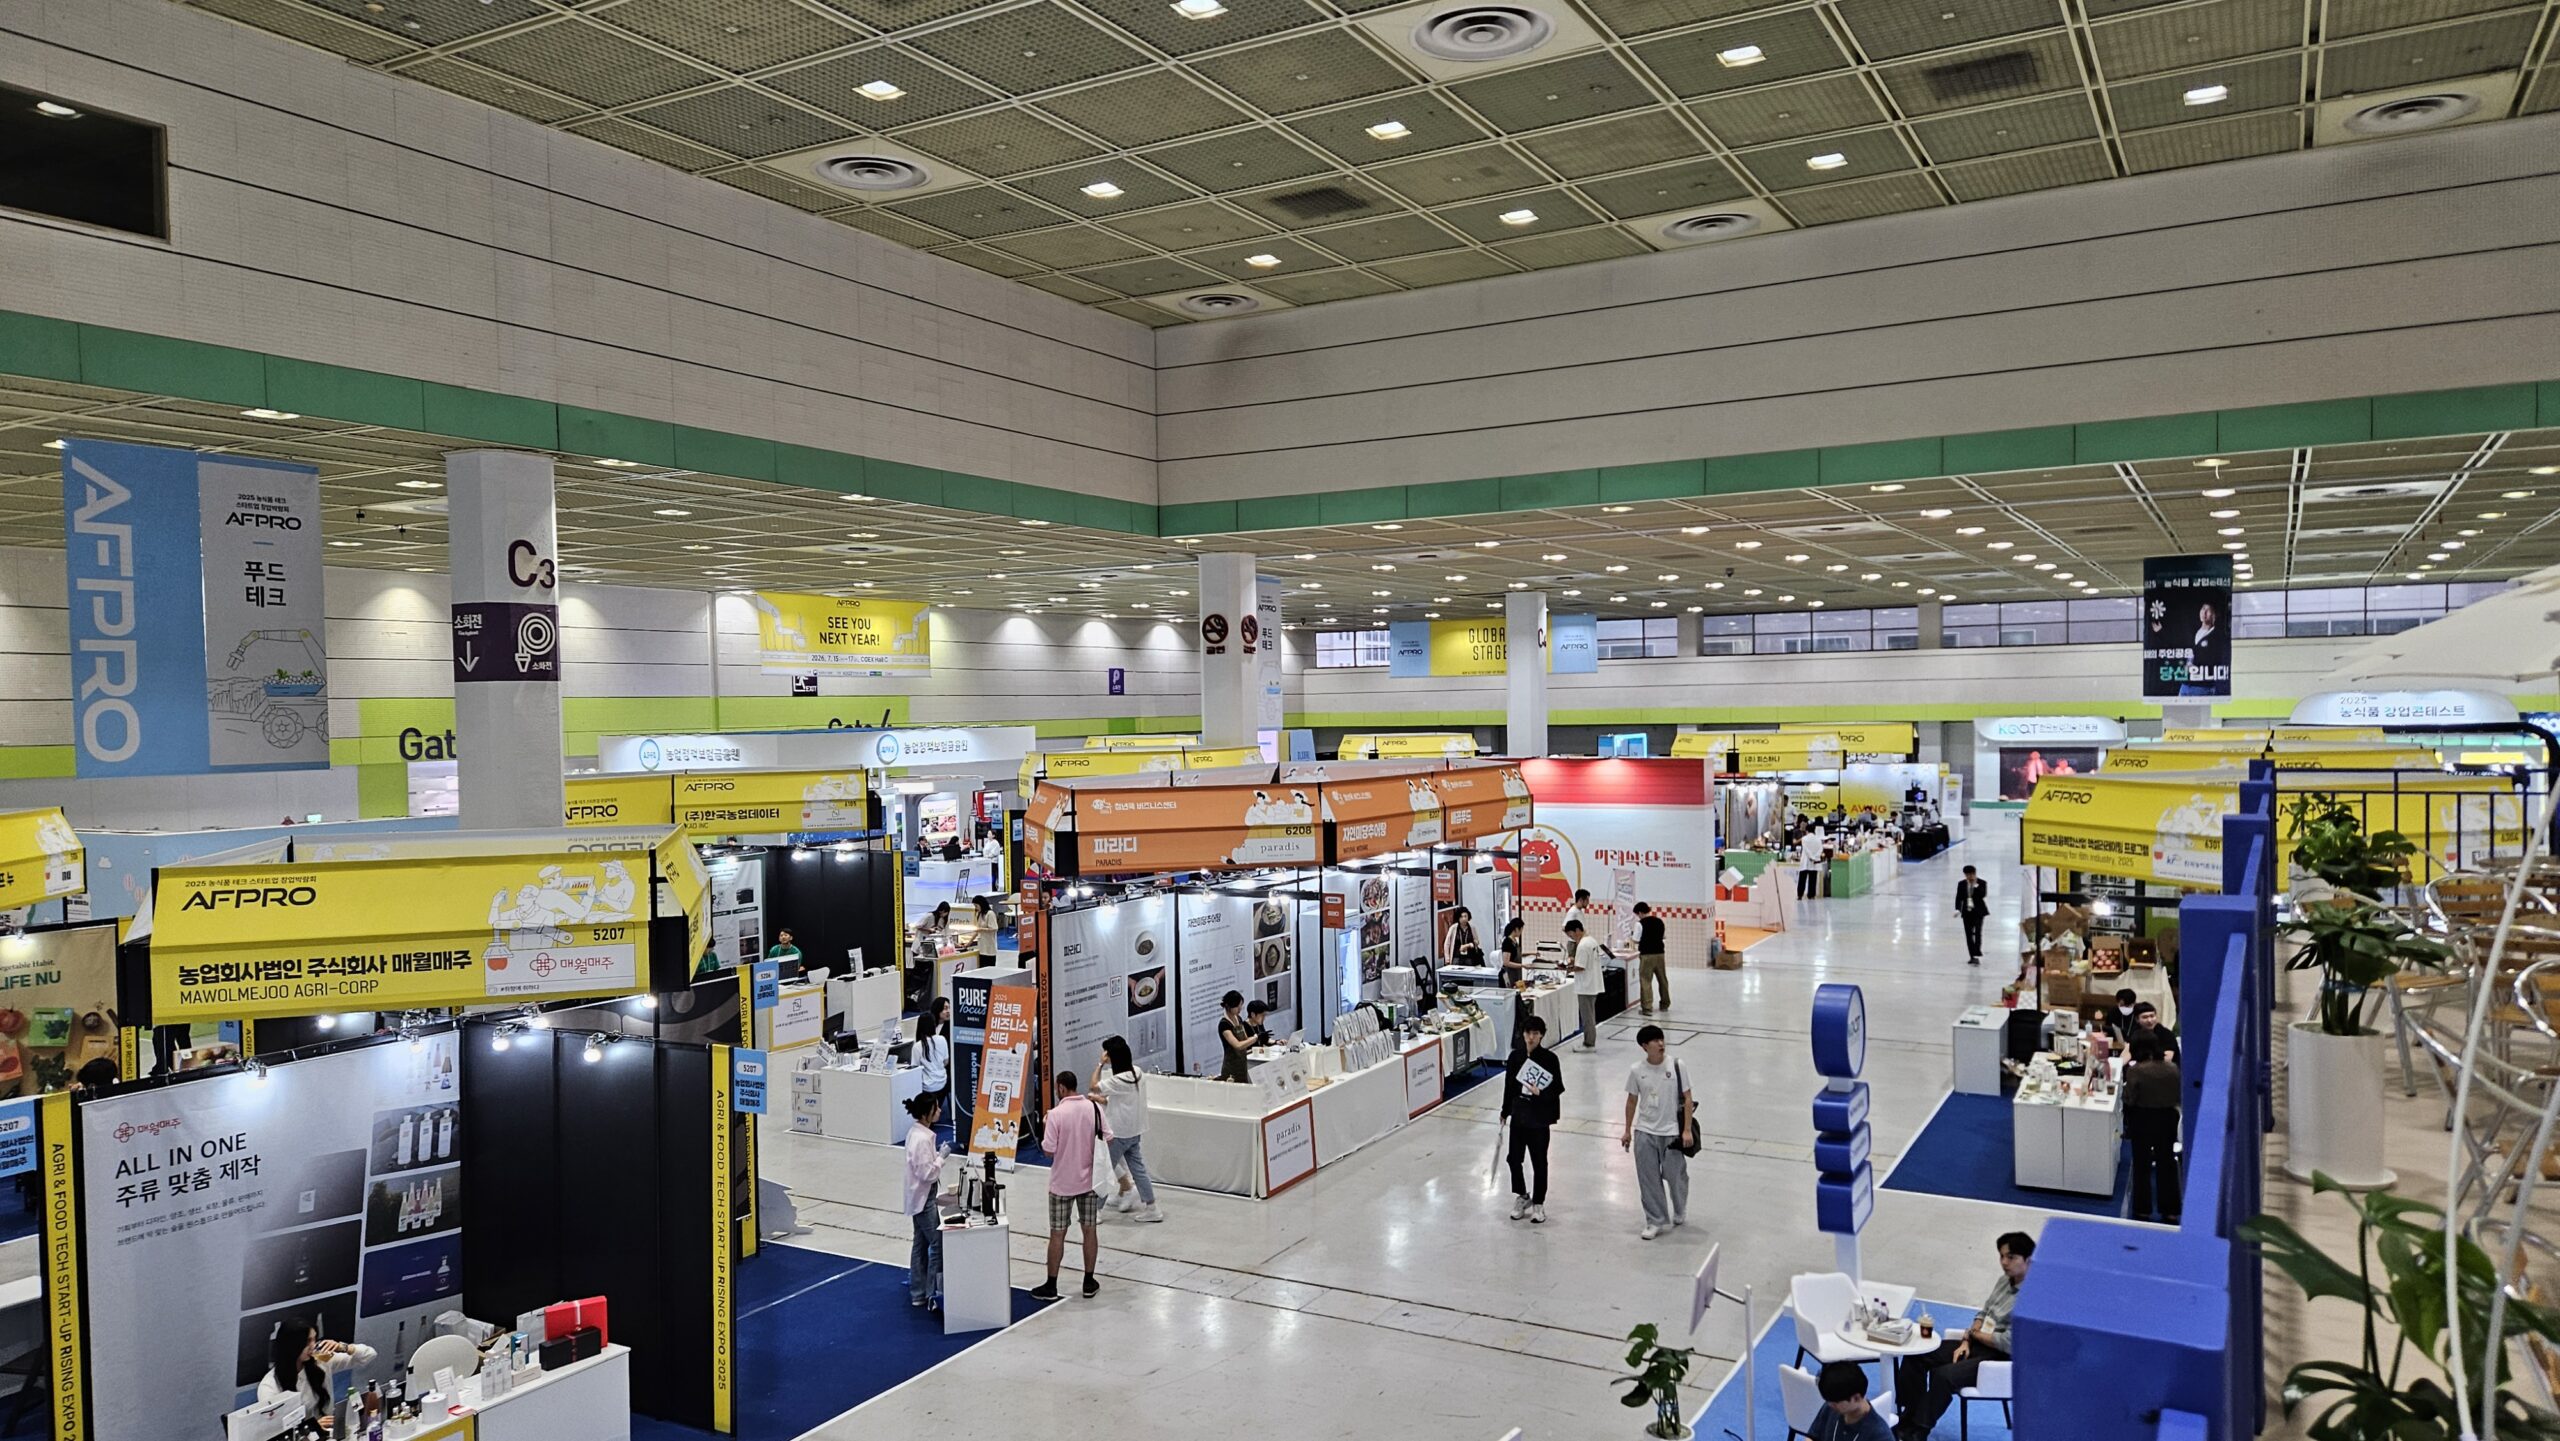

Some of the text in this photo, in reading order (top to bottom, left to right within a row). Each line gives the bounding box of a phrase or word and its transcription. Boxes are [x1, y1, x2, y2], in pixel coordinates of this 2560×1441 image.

[225, 511, 302, 531] AFPRO
[244, 561, 286, 583] 푸드
[245, 586, 286, 608] 테크
[71, 455, 141, 763] AFPRO
[454, 614, 483, 629] 소화전
[828, 616, 871, 630] SEE YOU
[819, 632, 880, 646] NEXT YEAR!
[1468, 627, 1506, 644] GLOBA
[1472, 645, 1507, 661] STAGE
[1560, 642, 1589, 651] AFPRO
[531, 661, 553, 671] 소화전
[2160, 665, 2230, 681] 당신입니다!
[2340, 695, 2368, 705] 2025
[2340, 705, 2467, 718] 농식품 창업콘테스트
[400, 727, 456, 761] Gat
[1839, 734, 1865, 743] PRO
[1053, 759, 1090, 767] AFPRO
[2110, 758, 2150, 769] AFPRO
[684, 782, 735, 792] AFPRO
[2040, 790, 2092, 804] AFPRO
[1791, 801, 1828, 812] FPRO
[1850, 804, 1888, 814] AVNG
[684, 808, 780, 822] (주)한국농업데이터
[1285, 825, 1312, 836] 6208
[1093, 836, 1138, 854] 파라디
[1260, 843, 1300, 854] paradis
[1095, 858, 1122, 867] PARADIS
[185, 880, 207, 888] 2025
[181, 886, 317, 911] AFPRO
[593, 927, 625, 941] 5207
[178, 950, 472, 986] 농업회사법인 주식회사 매월매주
[560, 956, 614, 975] 매월매주
[36, 970, 62, 986] NU
[180, 980, 379, 1004] MAWOLMEJOO AGRI-CORP
[959, 987, 987, 1007] PURE
[960, 1000, 986, 1016] focus
[992, 1001, 1022, 1017] 청년쿡
[990, 1017, 1029, 1033] 비즈니스
[988, 1032, 1009, 1045] 센터
[743, 1064, 757, 1074] 5207
[970, 1051, 978, 1079] MORE
[1276, 1120, 1302, 1144] paradis
[115, 1132, 247, 1179] ALL IN ONE
[115, 1154, 261, 1208] 주류 맞춤 제작
[716, 1089, 726, 1390] AGRI & FOOD TECH START-UP RISING EXPO 2025
[52, 1144, 76, 1432] AGRI & FOOD TECH START-UP RISING EXPO
